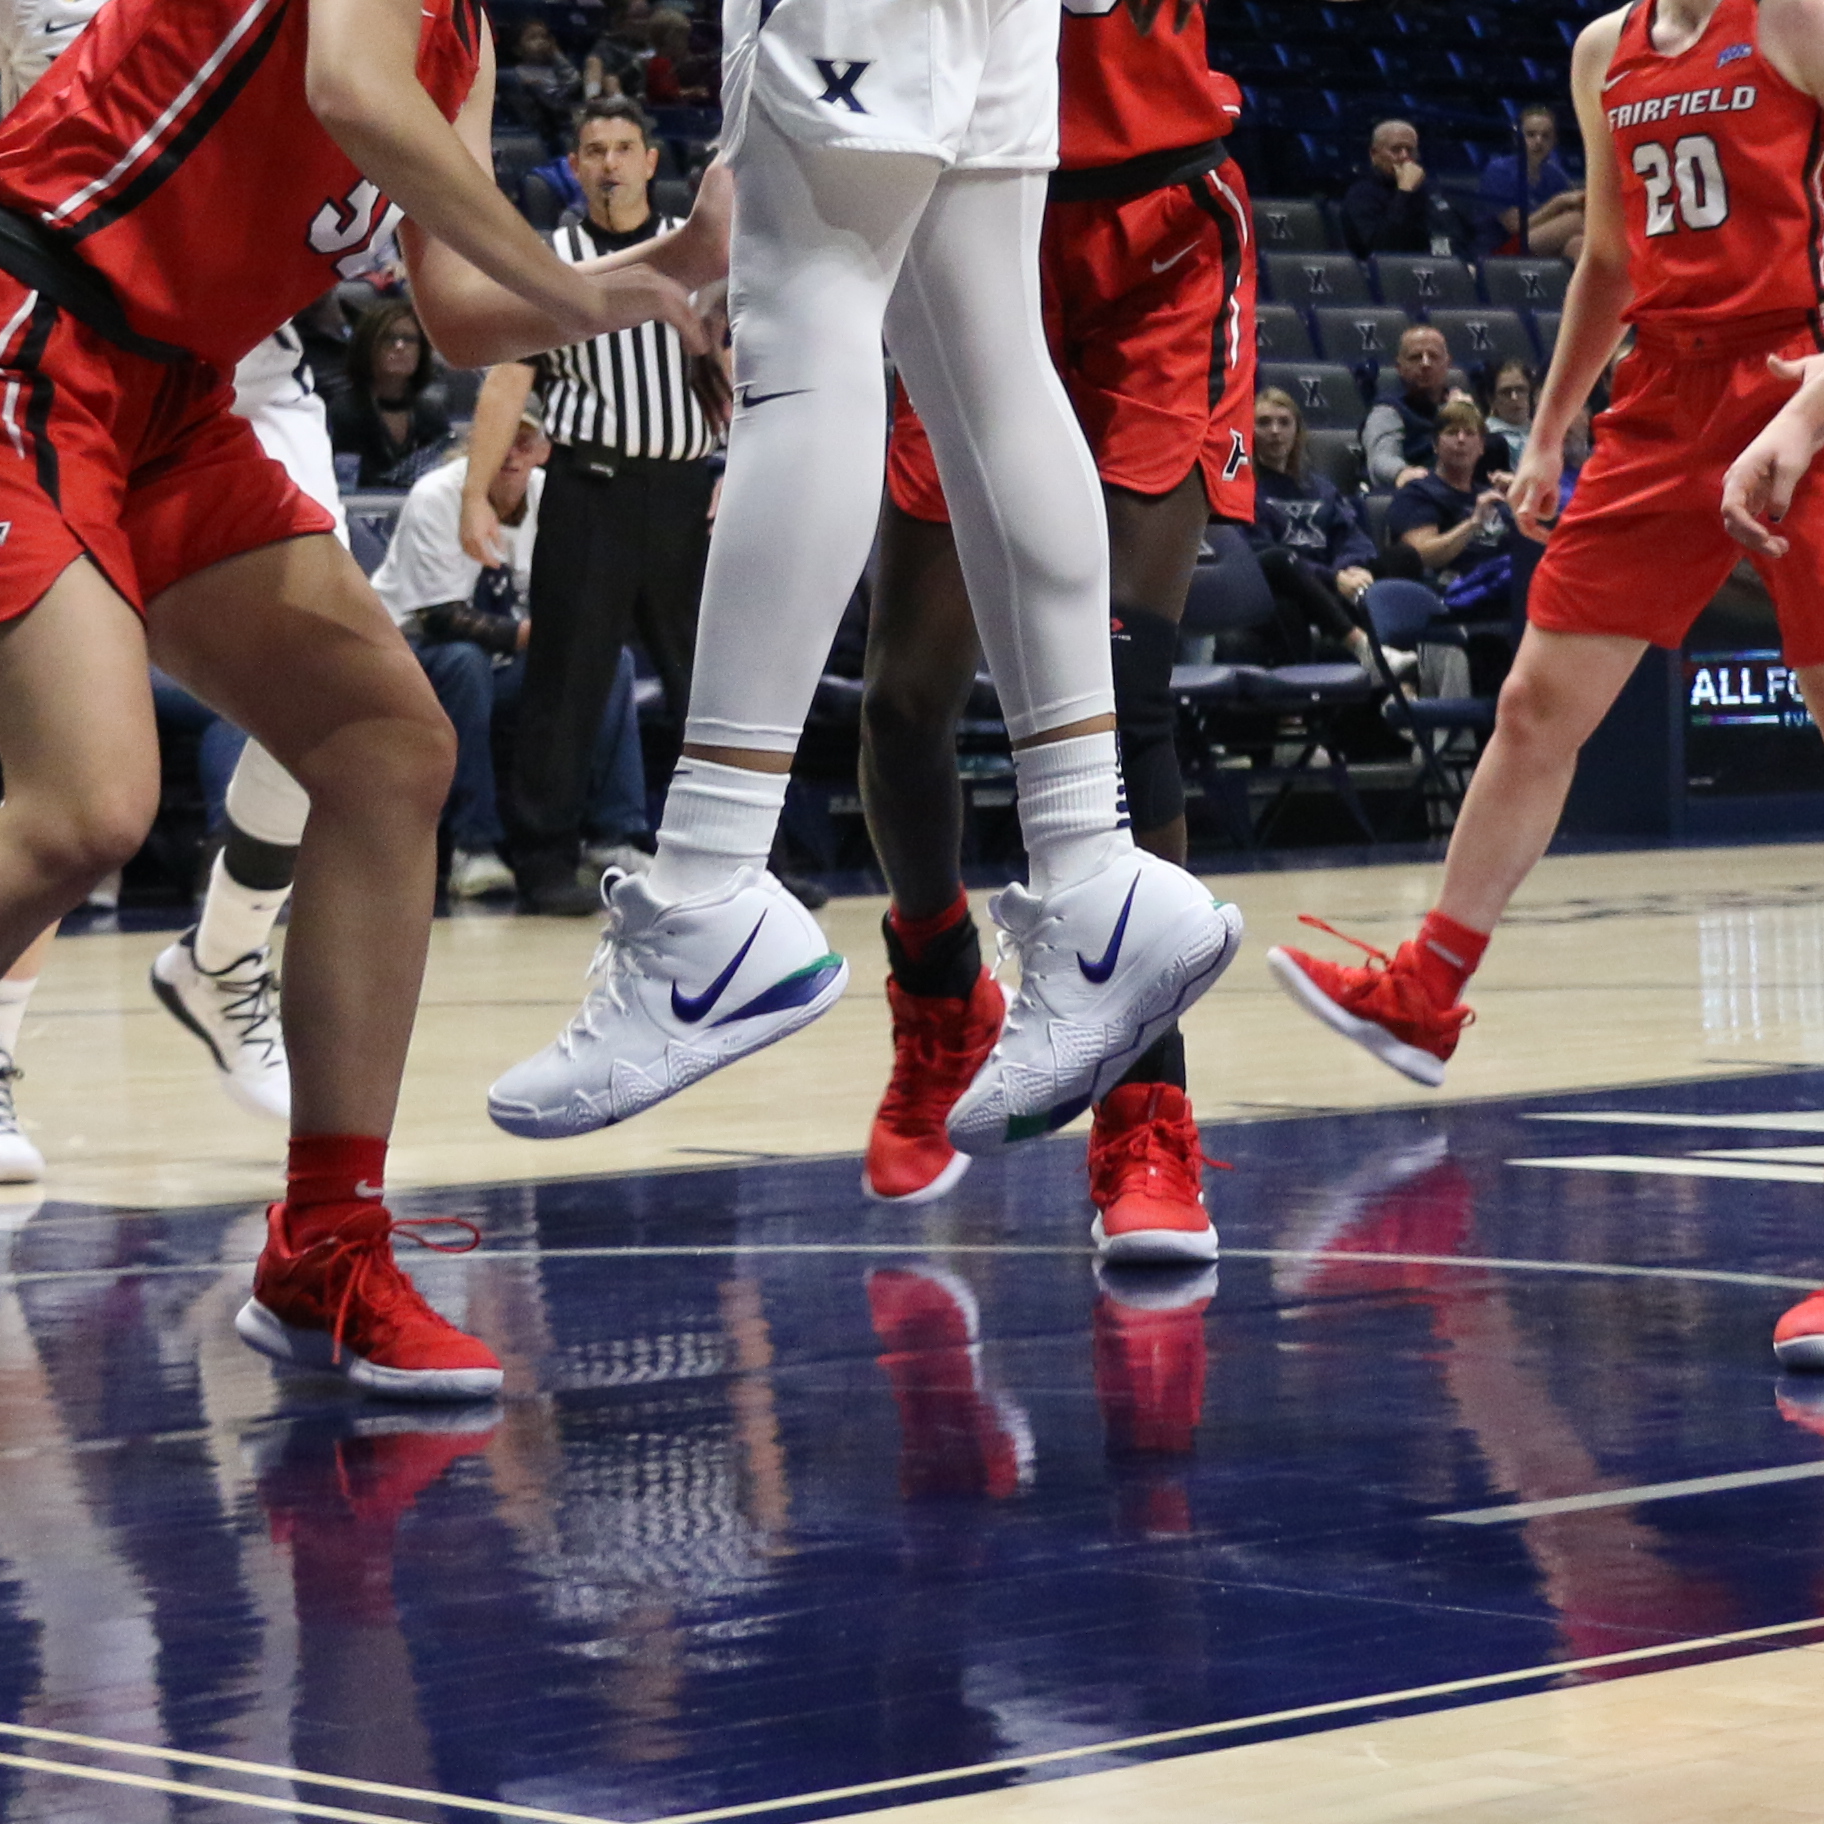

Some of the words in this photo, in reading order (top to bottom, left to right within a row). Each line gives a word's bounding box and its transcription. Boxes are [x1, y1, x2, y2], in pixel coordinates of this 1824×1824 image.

[813, 58, 875, 114] X
[1607, 85, 1757, 132] FAIRFIELD
[1632, 134, 1729, 237] 20
[1691, 668, 1763, 705] ALL
